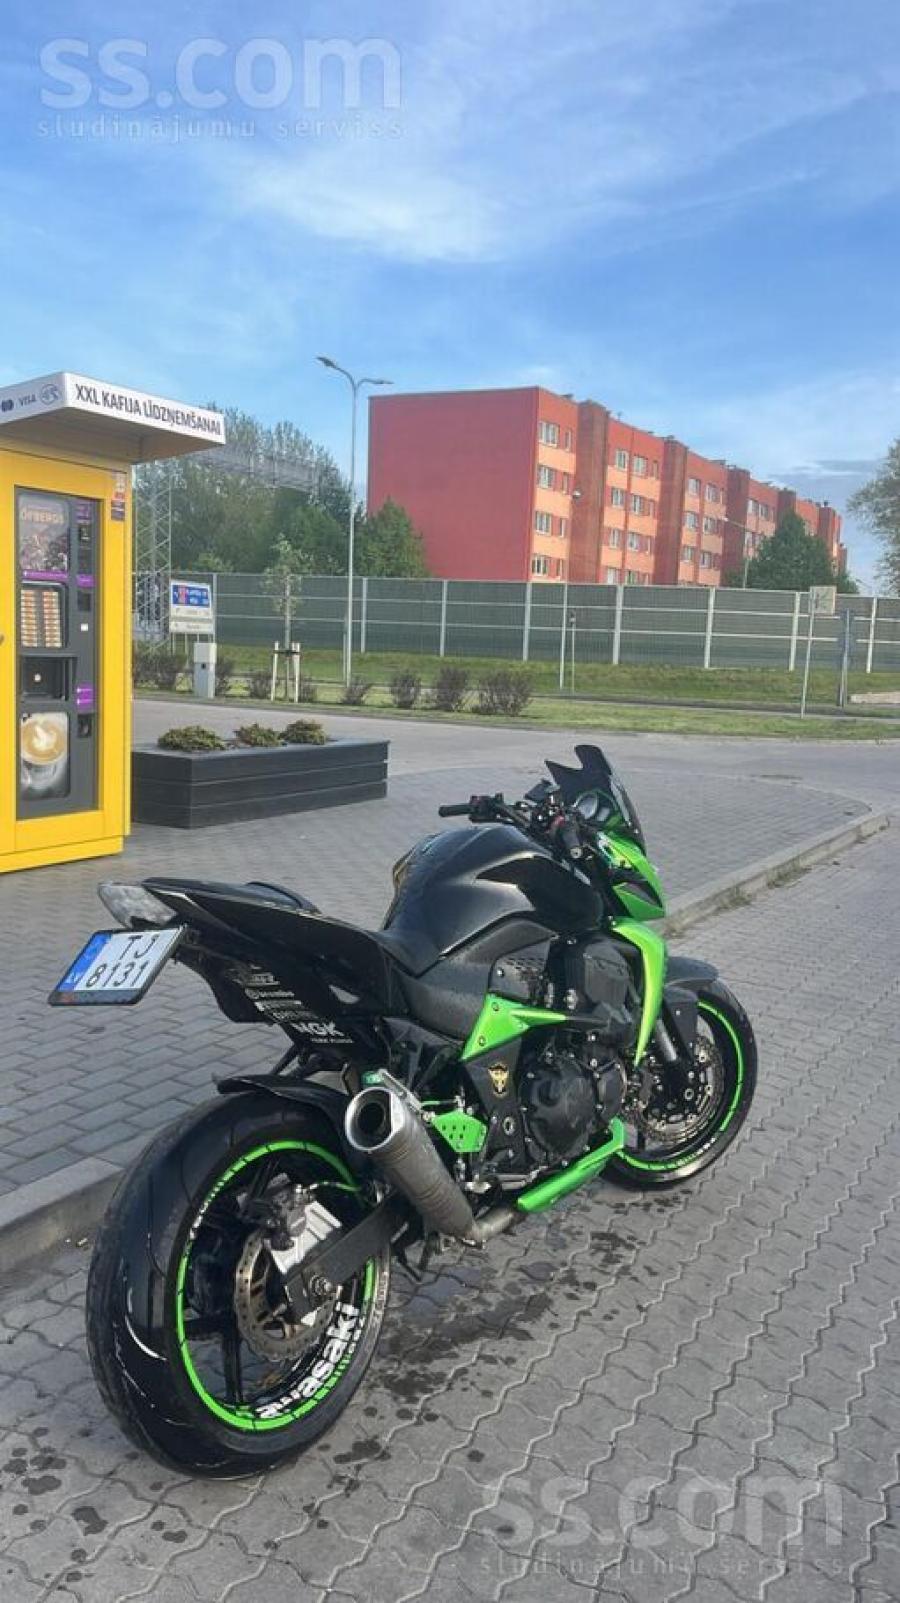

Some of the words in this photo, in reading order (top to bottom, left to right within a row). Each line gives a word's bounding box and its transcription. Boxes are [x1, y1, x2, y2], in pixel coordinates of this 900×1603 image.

[75, 383, 101, 405] XXL
[102, 390, 141, 416] KAFIJA
[119, 934, 159, 960] TJ
[86, 959, 149, 988] 8131
